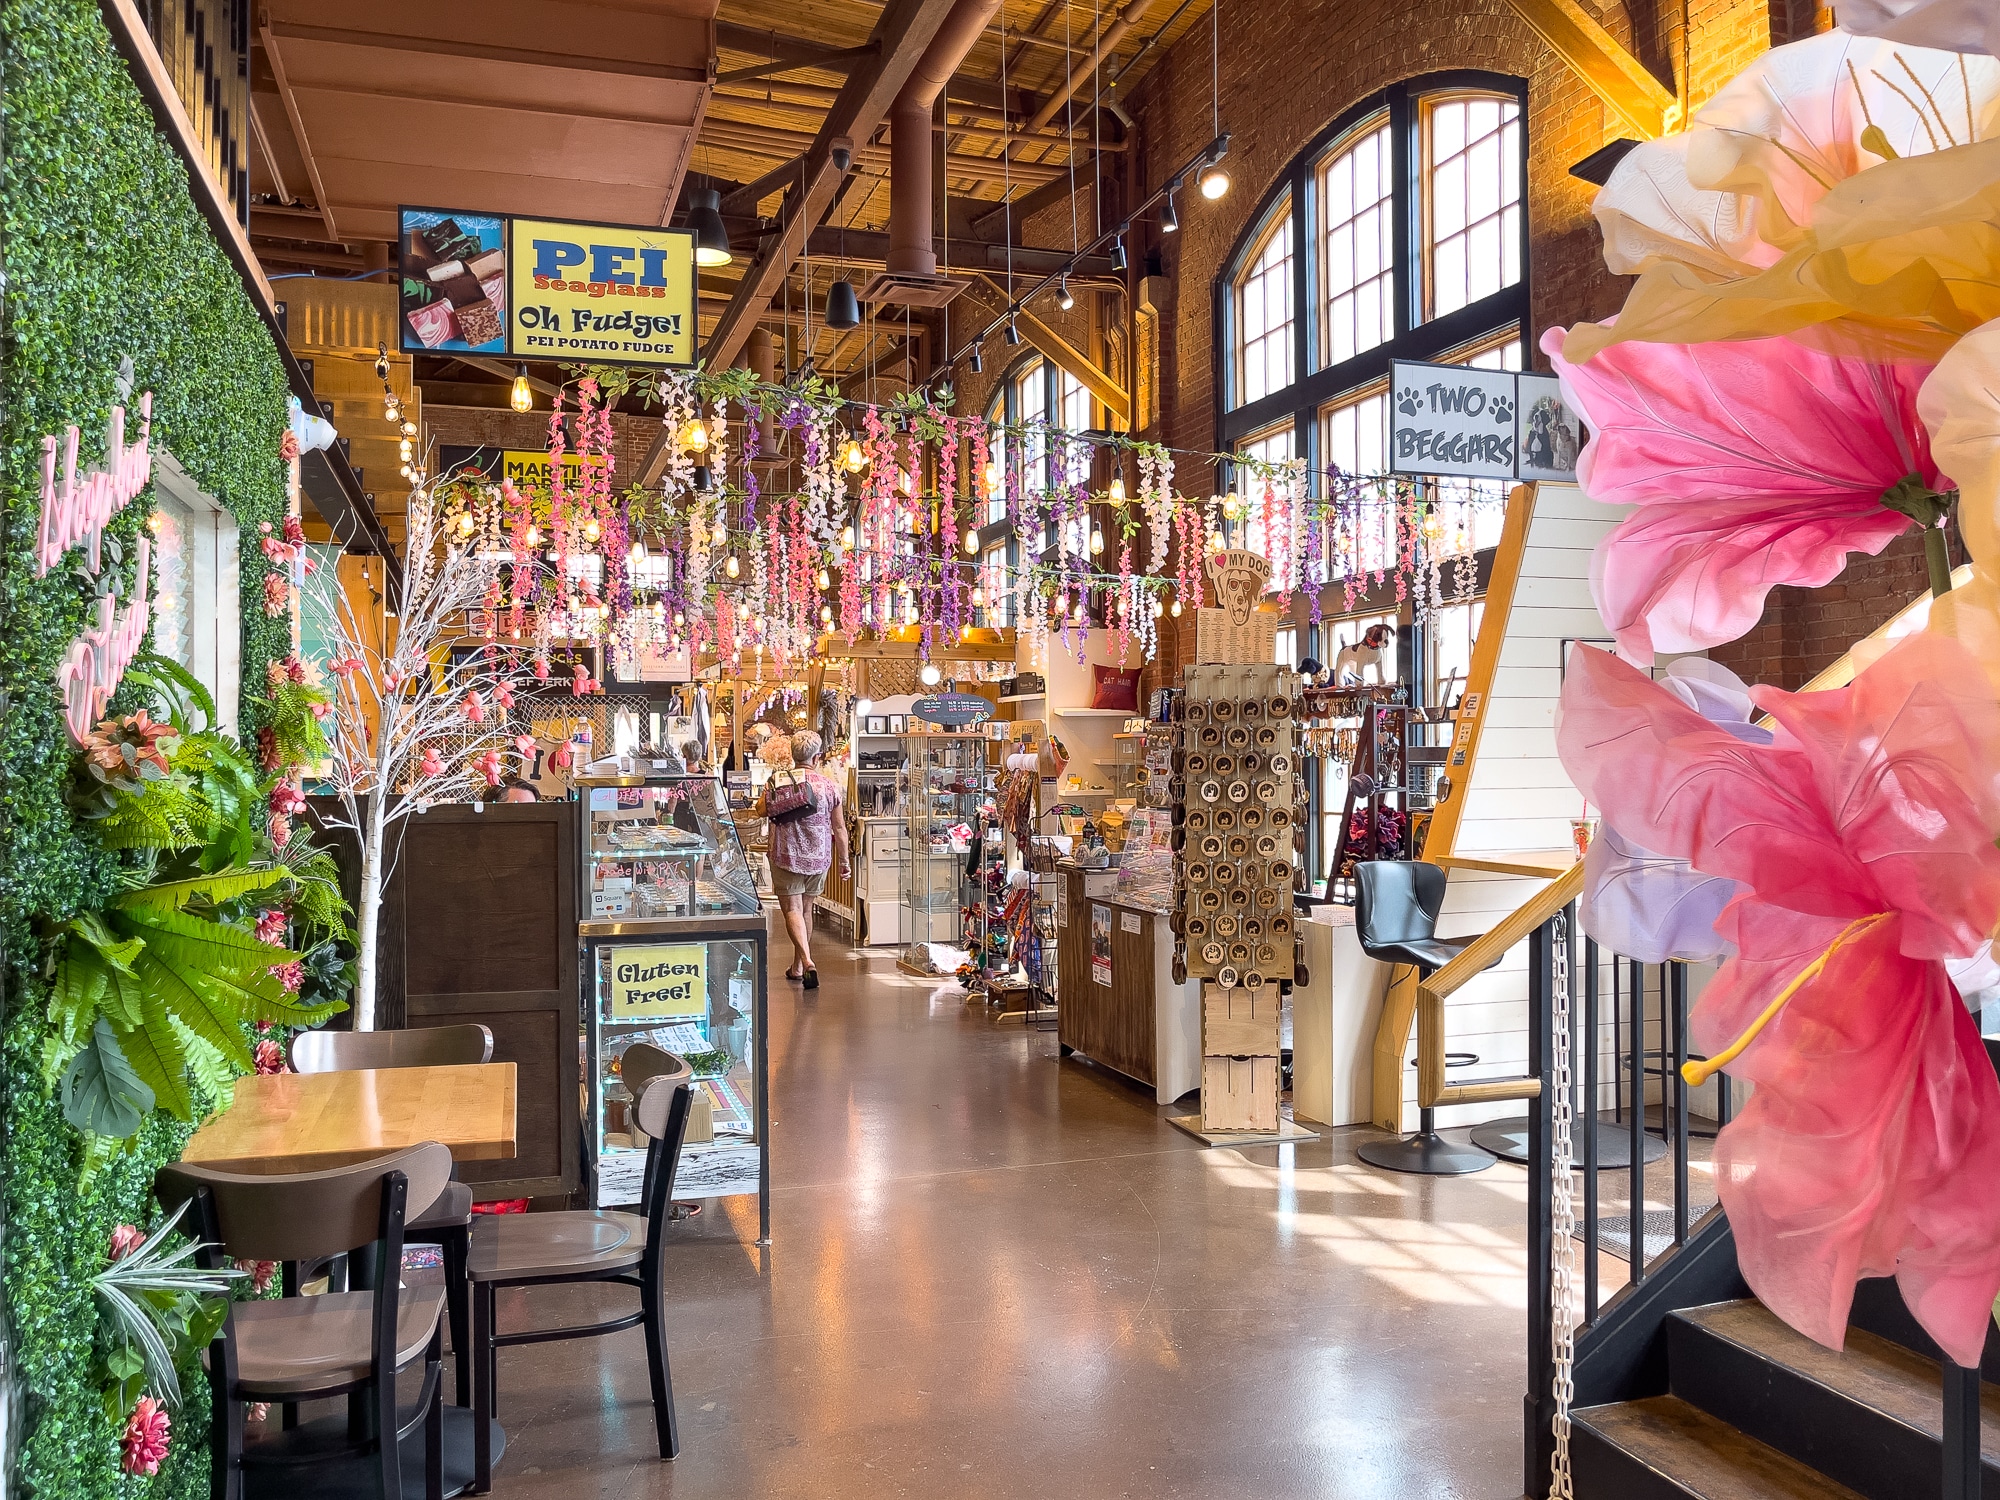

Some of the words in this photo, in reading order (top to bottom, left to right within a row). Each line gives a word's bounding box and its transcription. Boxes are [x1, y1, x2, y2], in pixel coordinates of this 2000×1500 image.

[532, 238, 668, 287] PEI
[534, 273, 667, 298] Seaglass
[518, 305, 561, 334] Oh
[571, 308, 682, 338] Fudge!
[526, 335, 554, 347] PEI
[557, 337, 619, 351] POTATO
[622, 342, 674, 354] FUDGE
[1426, 382, 1486, 418] TWO
[1396, 427, 1514, 468] BEGGARS
[1208, 561, 1214, 574] I
[1229, 553, 1245, 566] MY
[1248, 556, 1270, 577] DOG
[1104, 677, 1115, 685] CAT
[604, 895, 623, 903] Square
[617, 963, 700, 984] Gluten
[626, 982, 692, 1006] Free!
